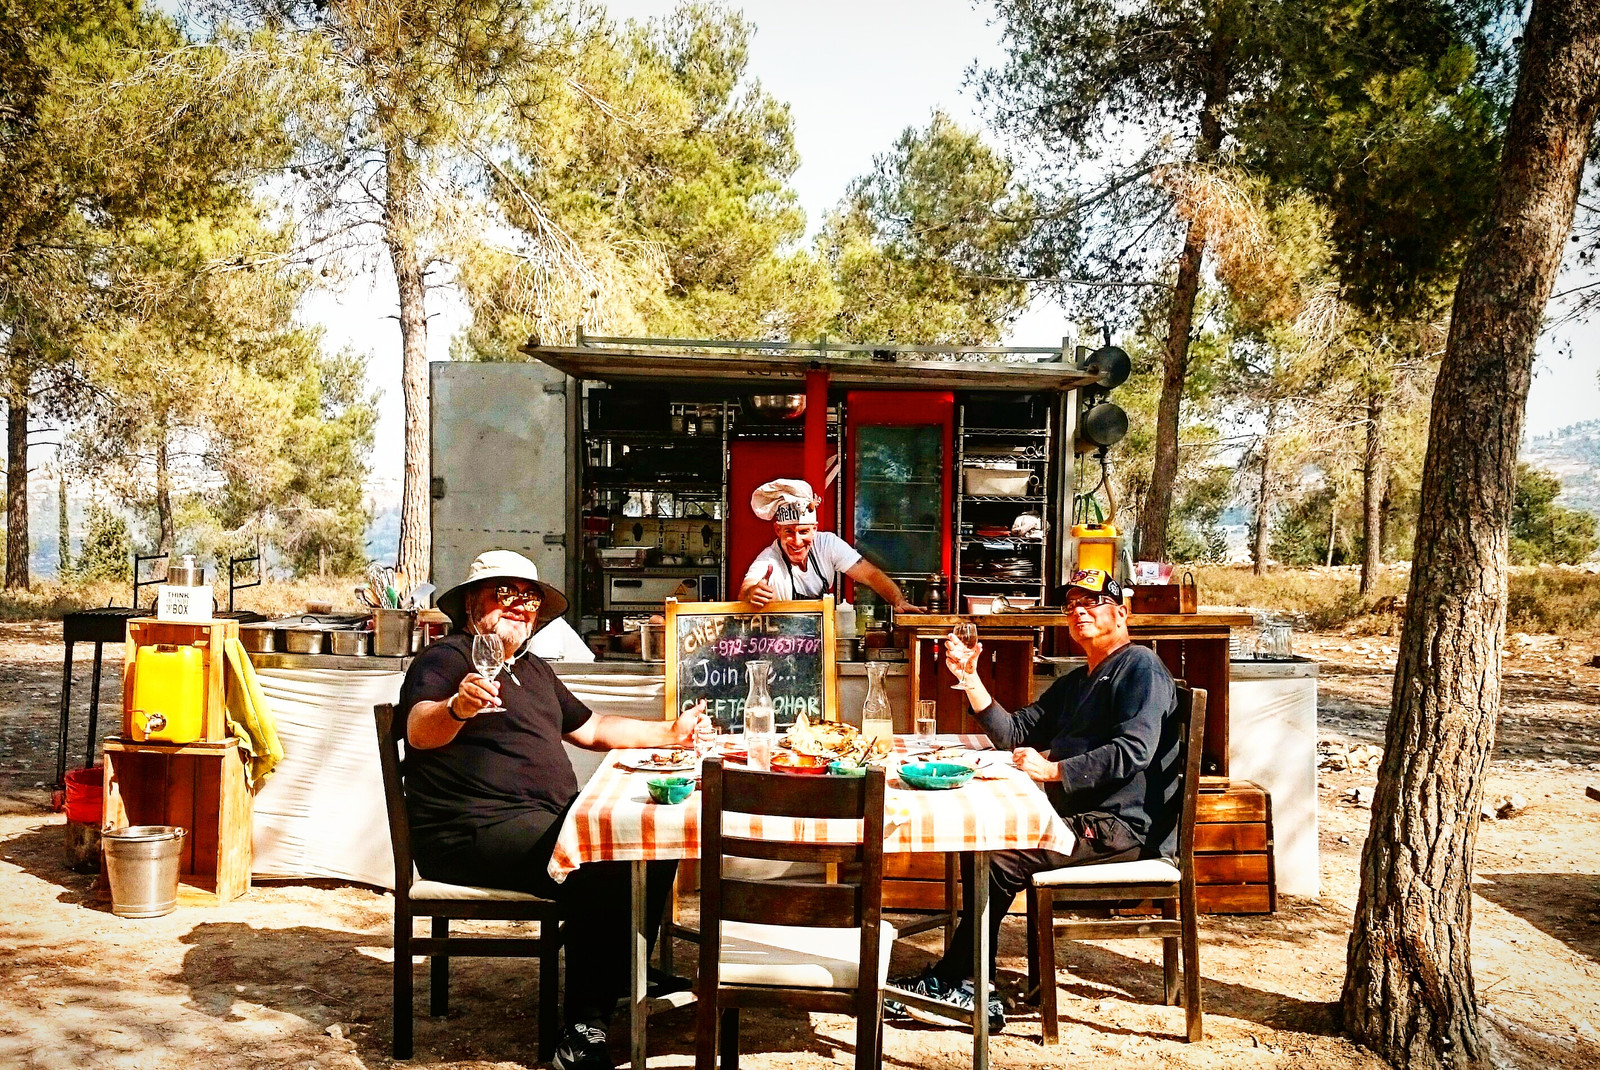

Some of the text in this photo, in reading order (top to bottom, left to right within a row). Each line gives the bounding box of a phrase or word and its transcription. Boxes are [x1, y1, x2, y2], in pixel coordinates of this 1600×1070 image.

[173, 604, 188, 614] BOX
[684, 614, 779, 653] CHEF TAL
[693, 659, 739, 687] Join
